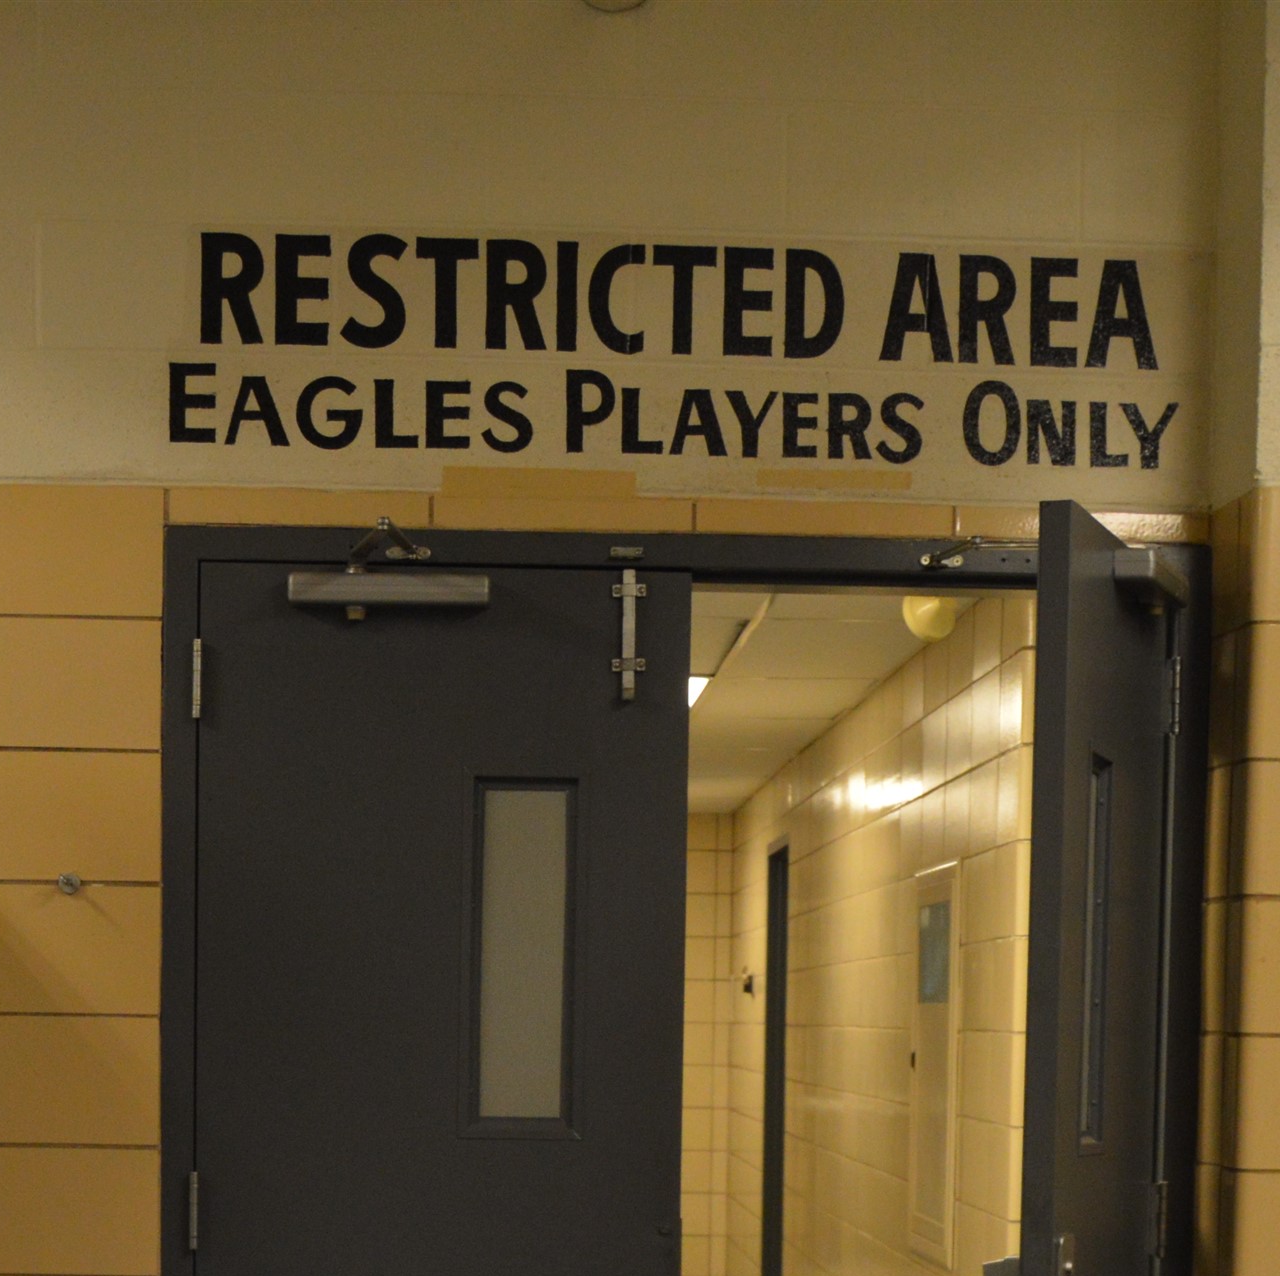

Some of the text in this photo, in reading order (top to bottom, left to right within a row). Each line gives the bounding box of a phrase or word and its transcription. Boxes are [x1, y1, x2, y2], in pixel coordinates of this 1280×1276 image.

[199, 231, 1159, 371] RESTRICTED AREA
[168, 361, 1179, 470] EAGLES PLAYERS ONLY
